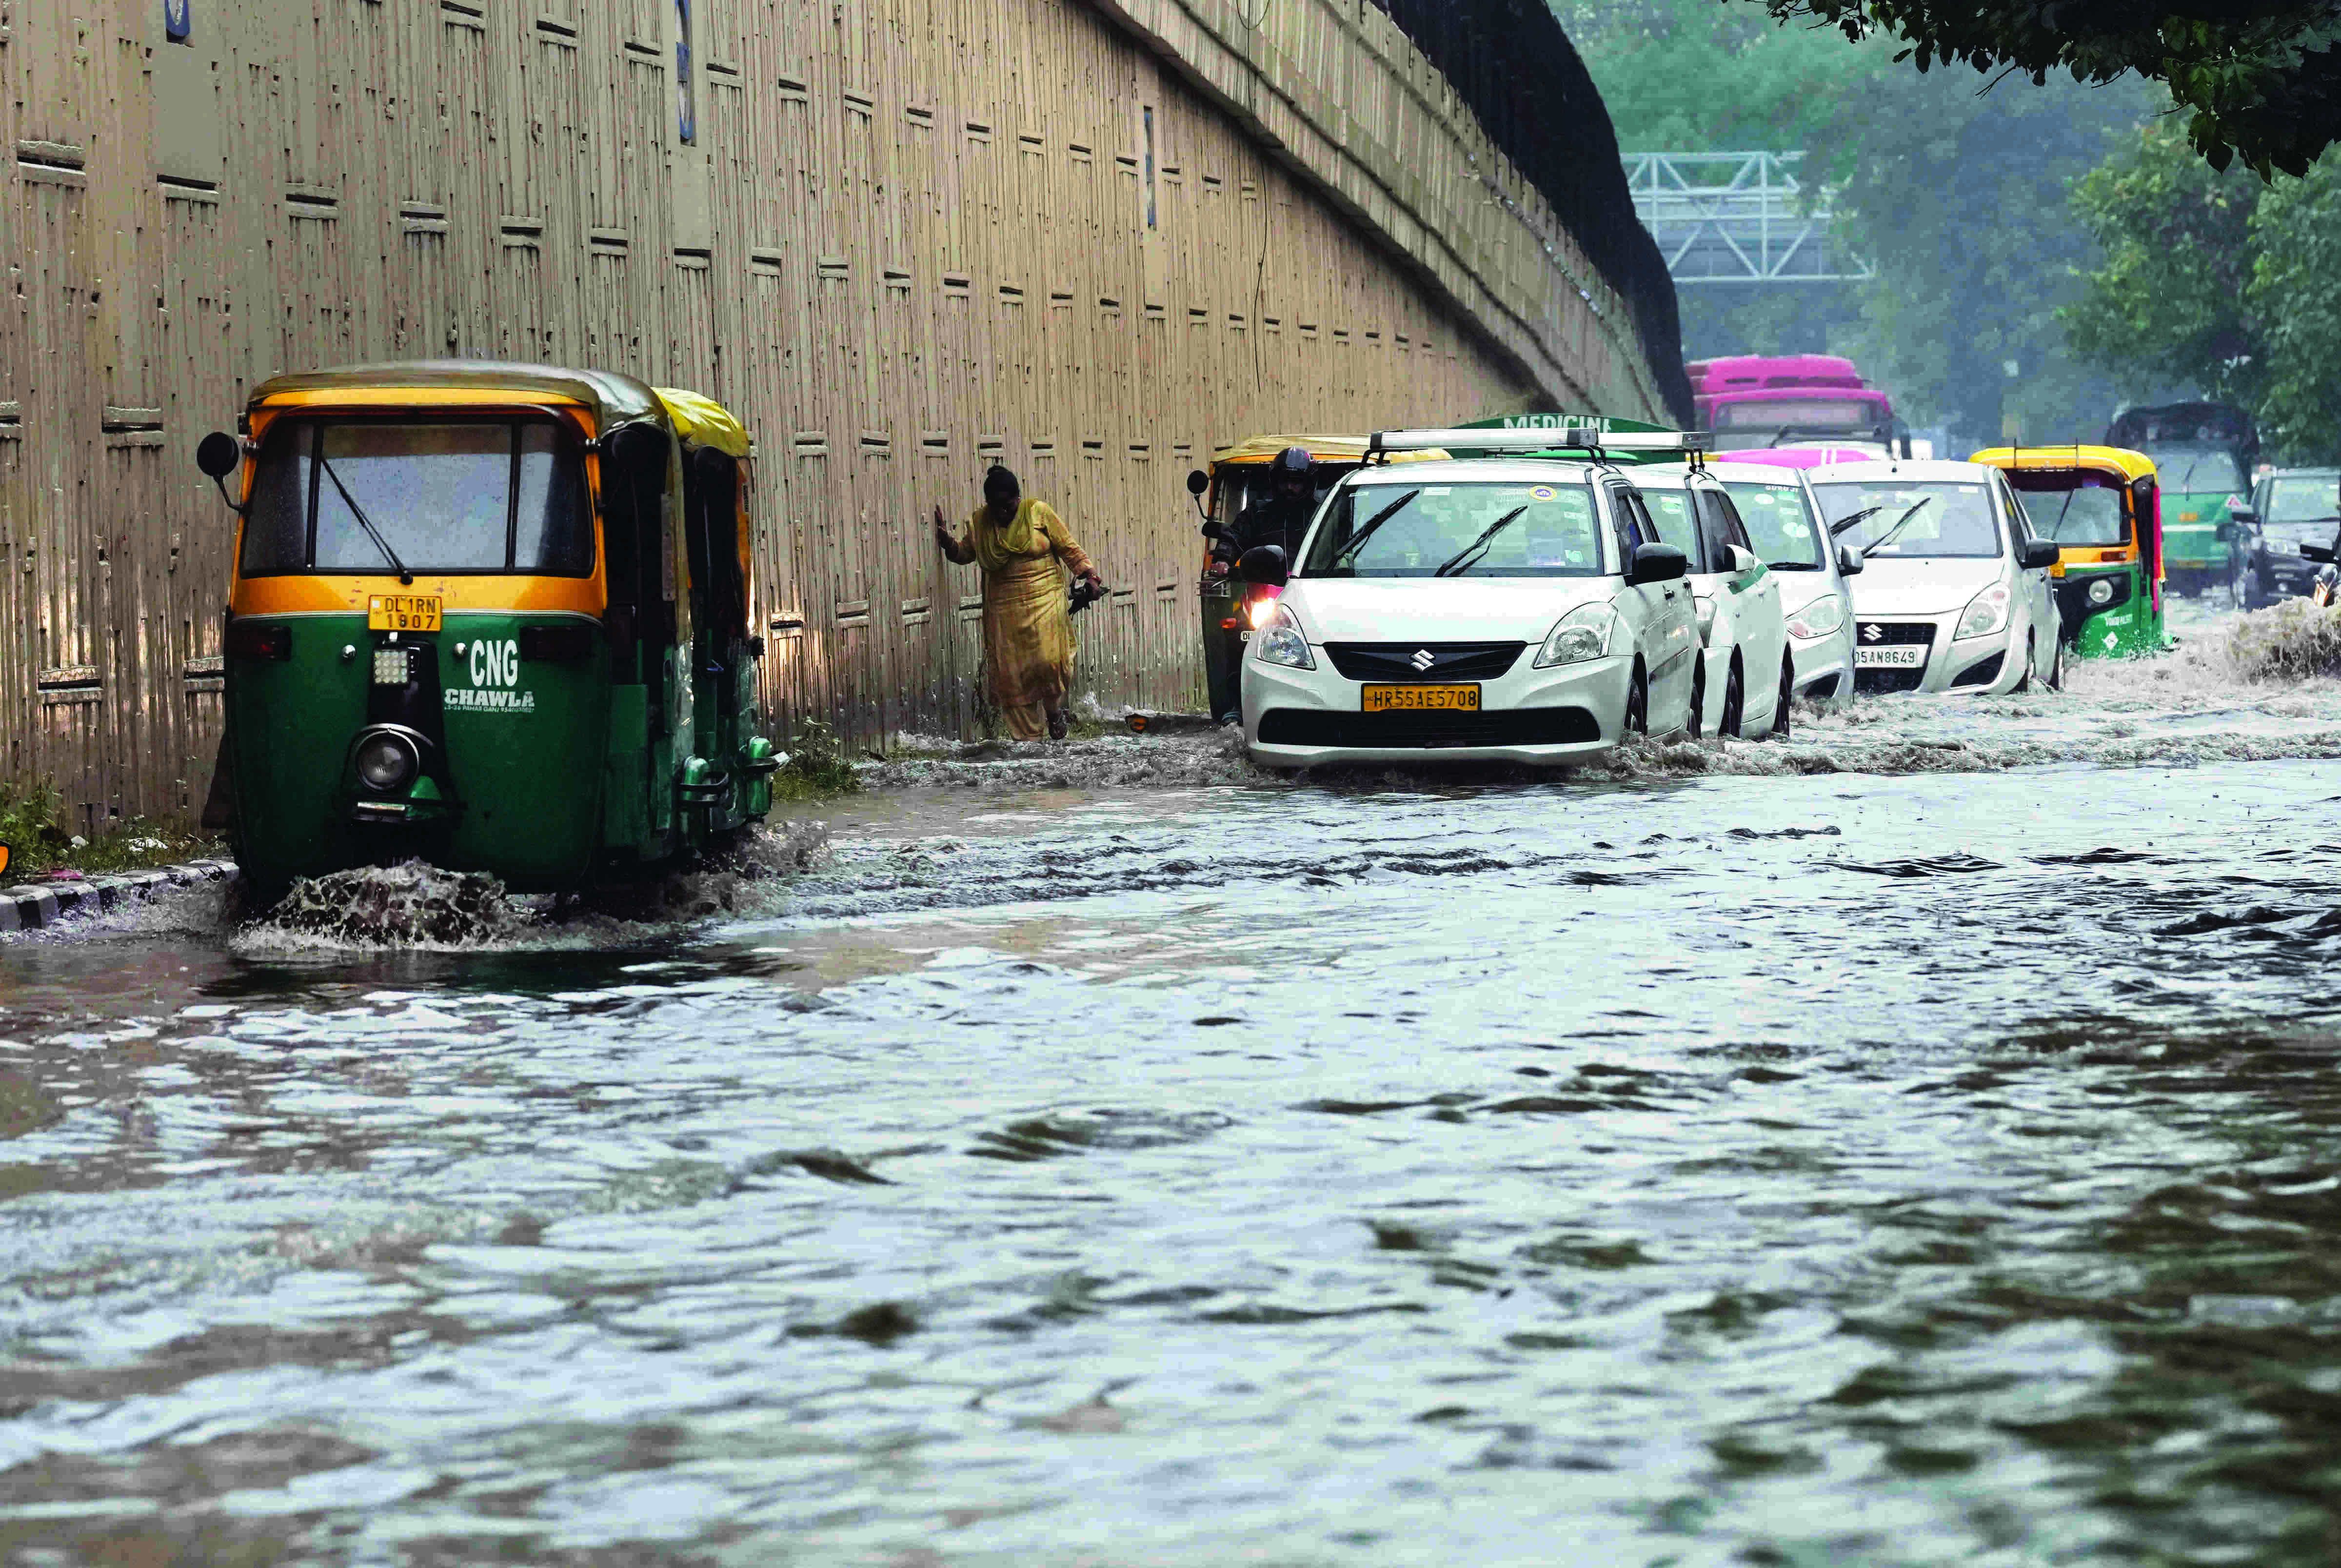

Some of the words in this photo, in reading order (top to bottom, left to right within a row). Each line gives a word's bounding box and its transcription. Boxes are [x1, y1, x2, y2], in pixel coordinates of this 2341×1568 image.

[385, 597, 404, 613] DL
[471, 639, 518, 687] CNG
[444, 688, 535, 707] CHAWLA
[1374, 690, 1477, 707] HR55AE5708
